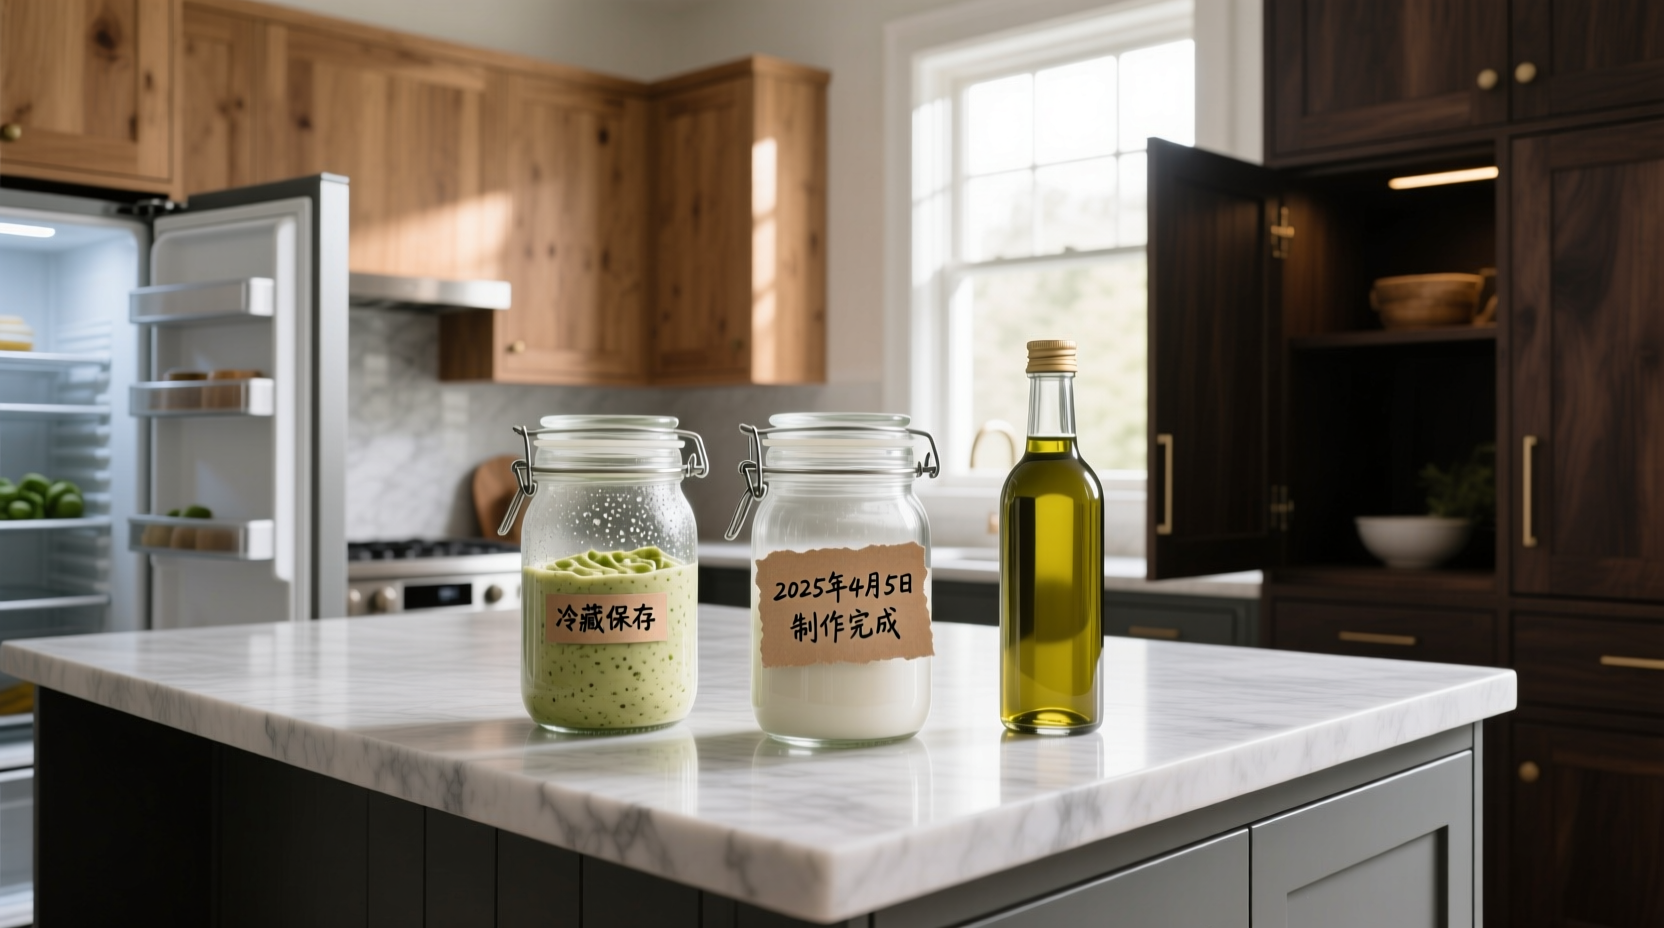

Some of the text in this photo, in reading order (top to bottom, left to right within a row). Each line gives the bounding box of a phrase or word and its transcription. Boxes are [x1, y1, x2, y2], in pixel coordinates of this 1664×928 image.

[773, 570, 912, 603] 2025年4月5日
[555, 603, 656, 634] 冷藏保存
[789, 606, 901, 643] 制作完成
